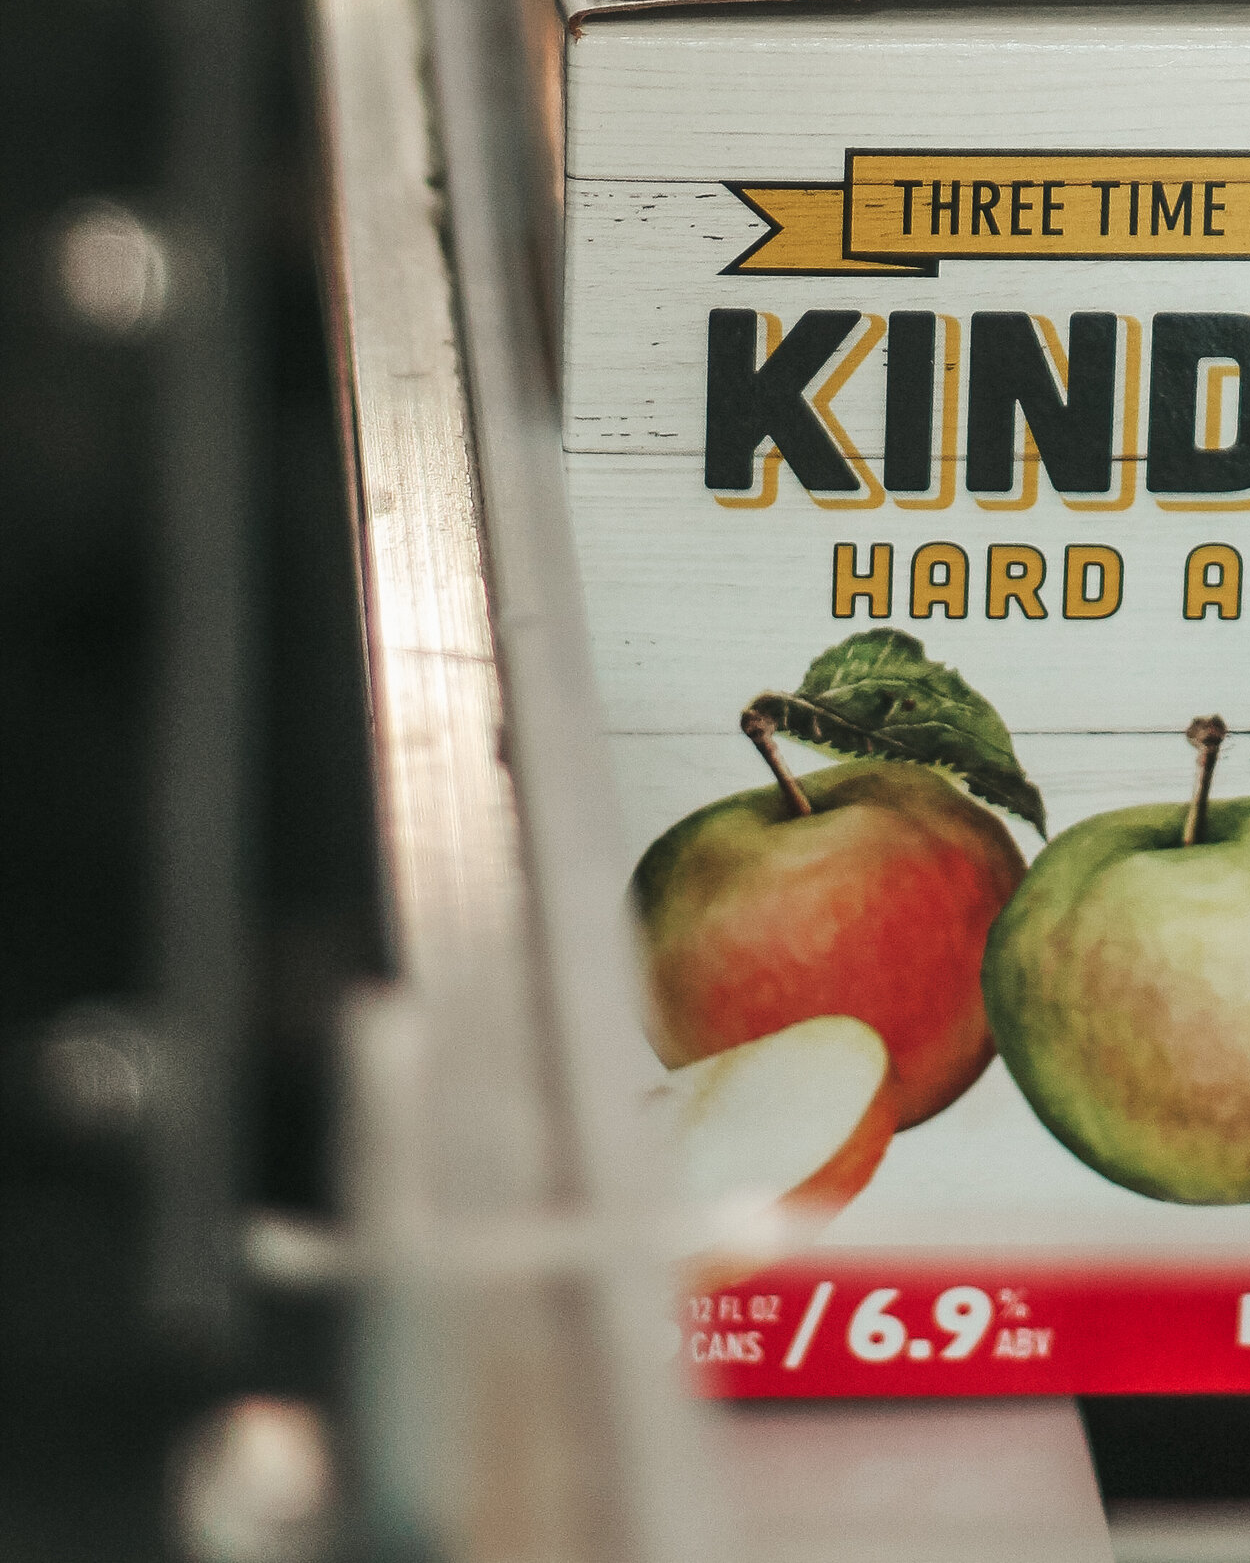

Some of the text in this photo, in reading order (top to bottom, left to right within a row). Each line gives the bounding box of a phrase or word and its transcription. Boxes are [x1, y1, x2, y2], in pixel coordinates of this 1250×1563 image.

[894, 179, 1066, 236] THREE
[1092, 179, 1228, 236] TIME
[831, 542, 1125, 620] HARD
[689, 1294, 781, 1322] 12 FL OZ
[847, 1285, 994, 1363] 6.9
[691, 1331, 765, 1364] CANS
[993, 1328, 1054, 1358] ABV
